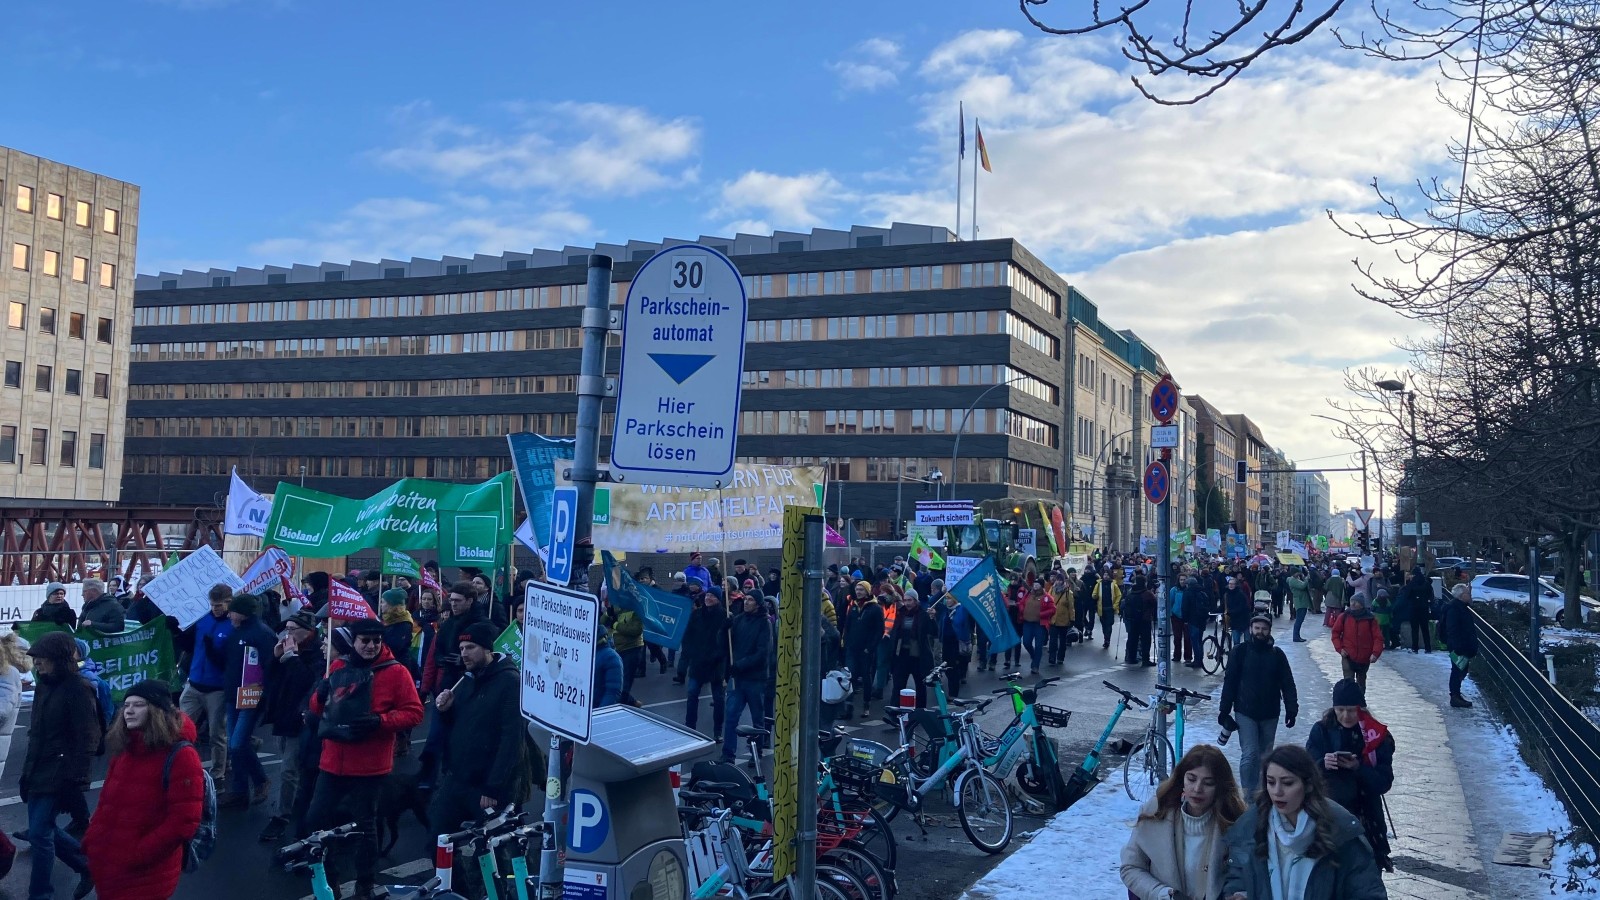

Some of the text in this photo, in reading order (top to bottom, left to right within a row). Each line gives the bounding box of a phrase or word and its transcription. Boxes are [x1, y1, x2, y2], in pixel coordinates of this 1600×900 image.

[673, 261, 703, 289] 30
[640, 297, 730, 316] Parkschein-
[652, 324, 714, 342] automat
[657, 397, 695, 415] Hier
[625, 419, 724, 440] Parkschein
[648, 443, 696, 462] lösen
[920, 513, 946, 523] Zukunft
[279, 525, 321, 543] Bioland
[552, 498, 570, 568] P
[459, 546, 494, 559] Bioland
[530, 593, 590, 622] mit Parkschein oder
[527, 612, 591, 645] Bewohnerparkausweis
[542, 638, 579, 662] für Zone 15
[553, 681, 579, 705] 09-22
[580, 688, 586, 708] h
[572, 792, 603, 848] P
